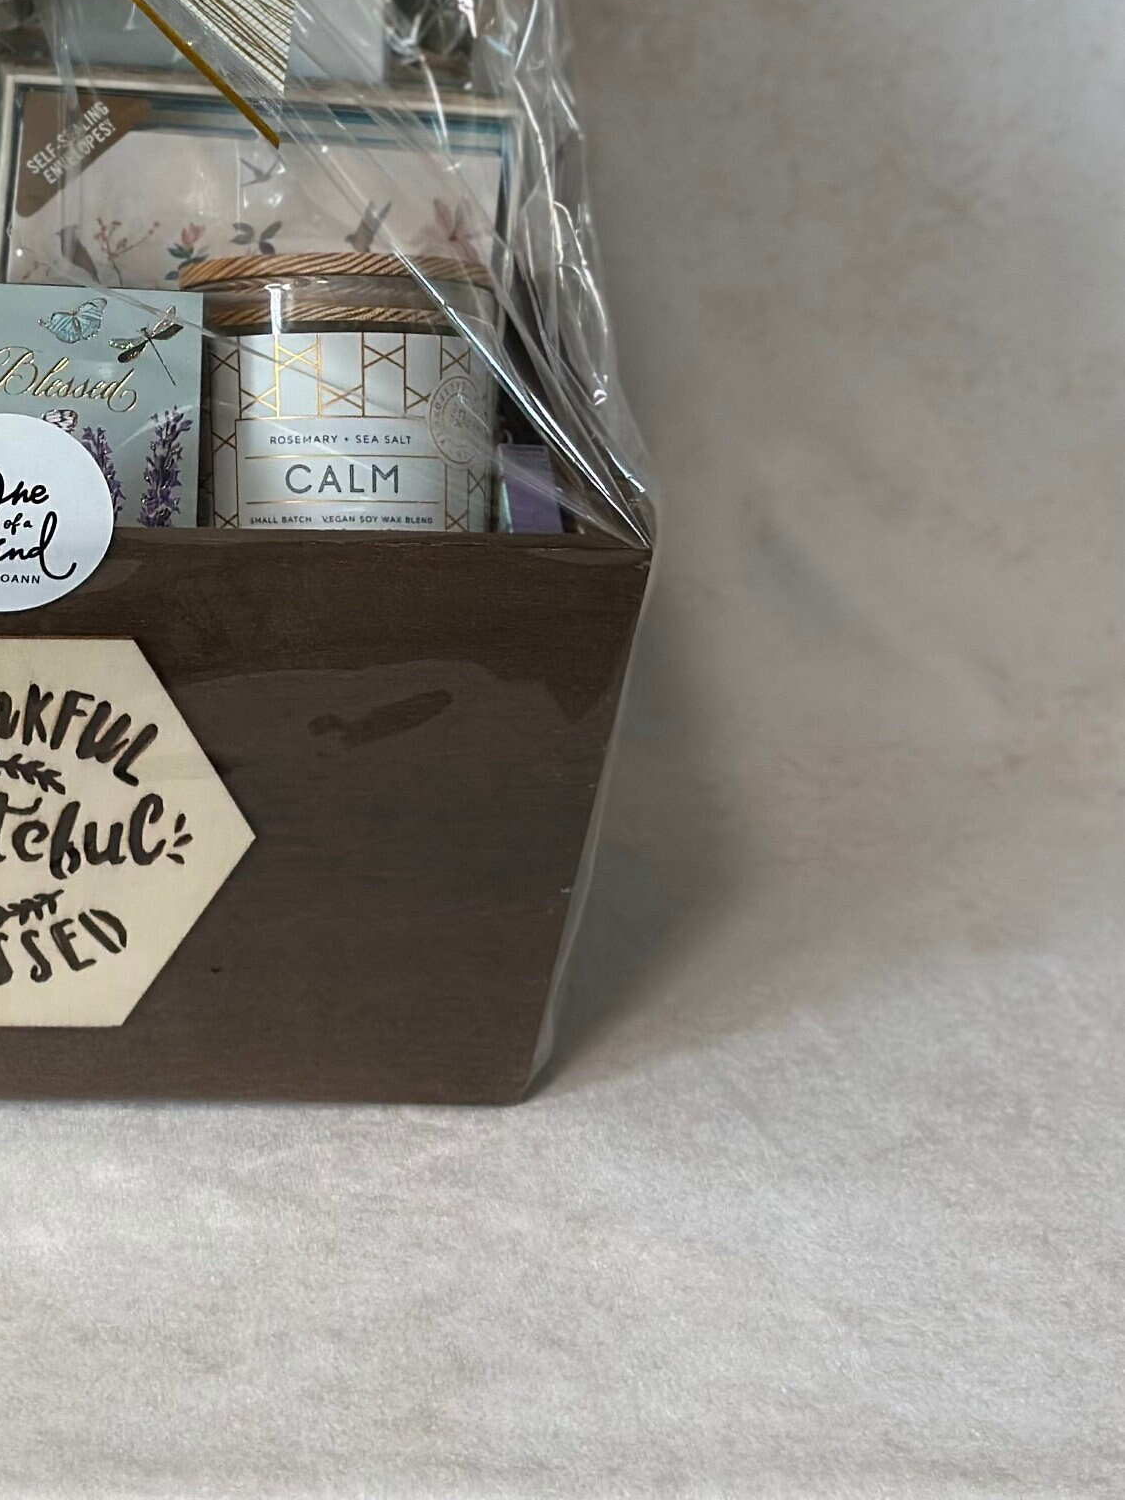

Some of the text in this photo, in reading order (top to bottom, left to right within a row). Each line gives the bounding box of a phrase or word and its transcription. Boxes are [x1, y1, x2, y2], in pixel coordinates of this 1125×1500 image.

[270, 435, 412, 445] ROSEMARY SEA SALT
[285, 464, 399, 494] CALM
[3, 512, 33, 537] of a
[249, 515, 434, 525] SMALL BATCH VEGAN SOY WAX BLEND
